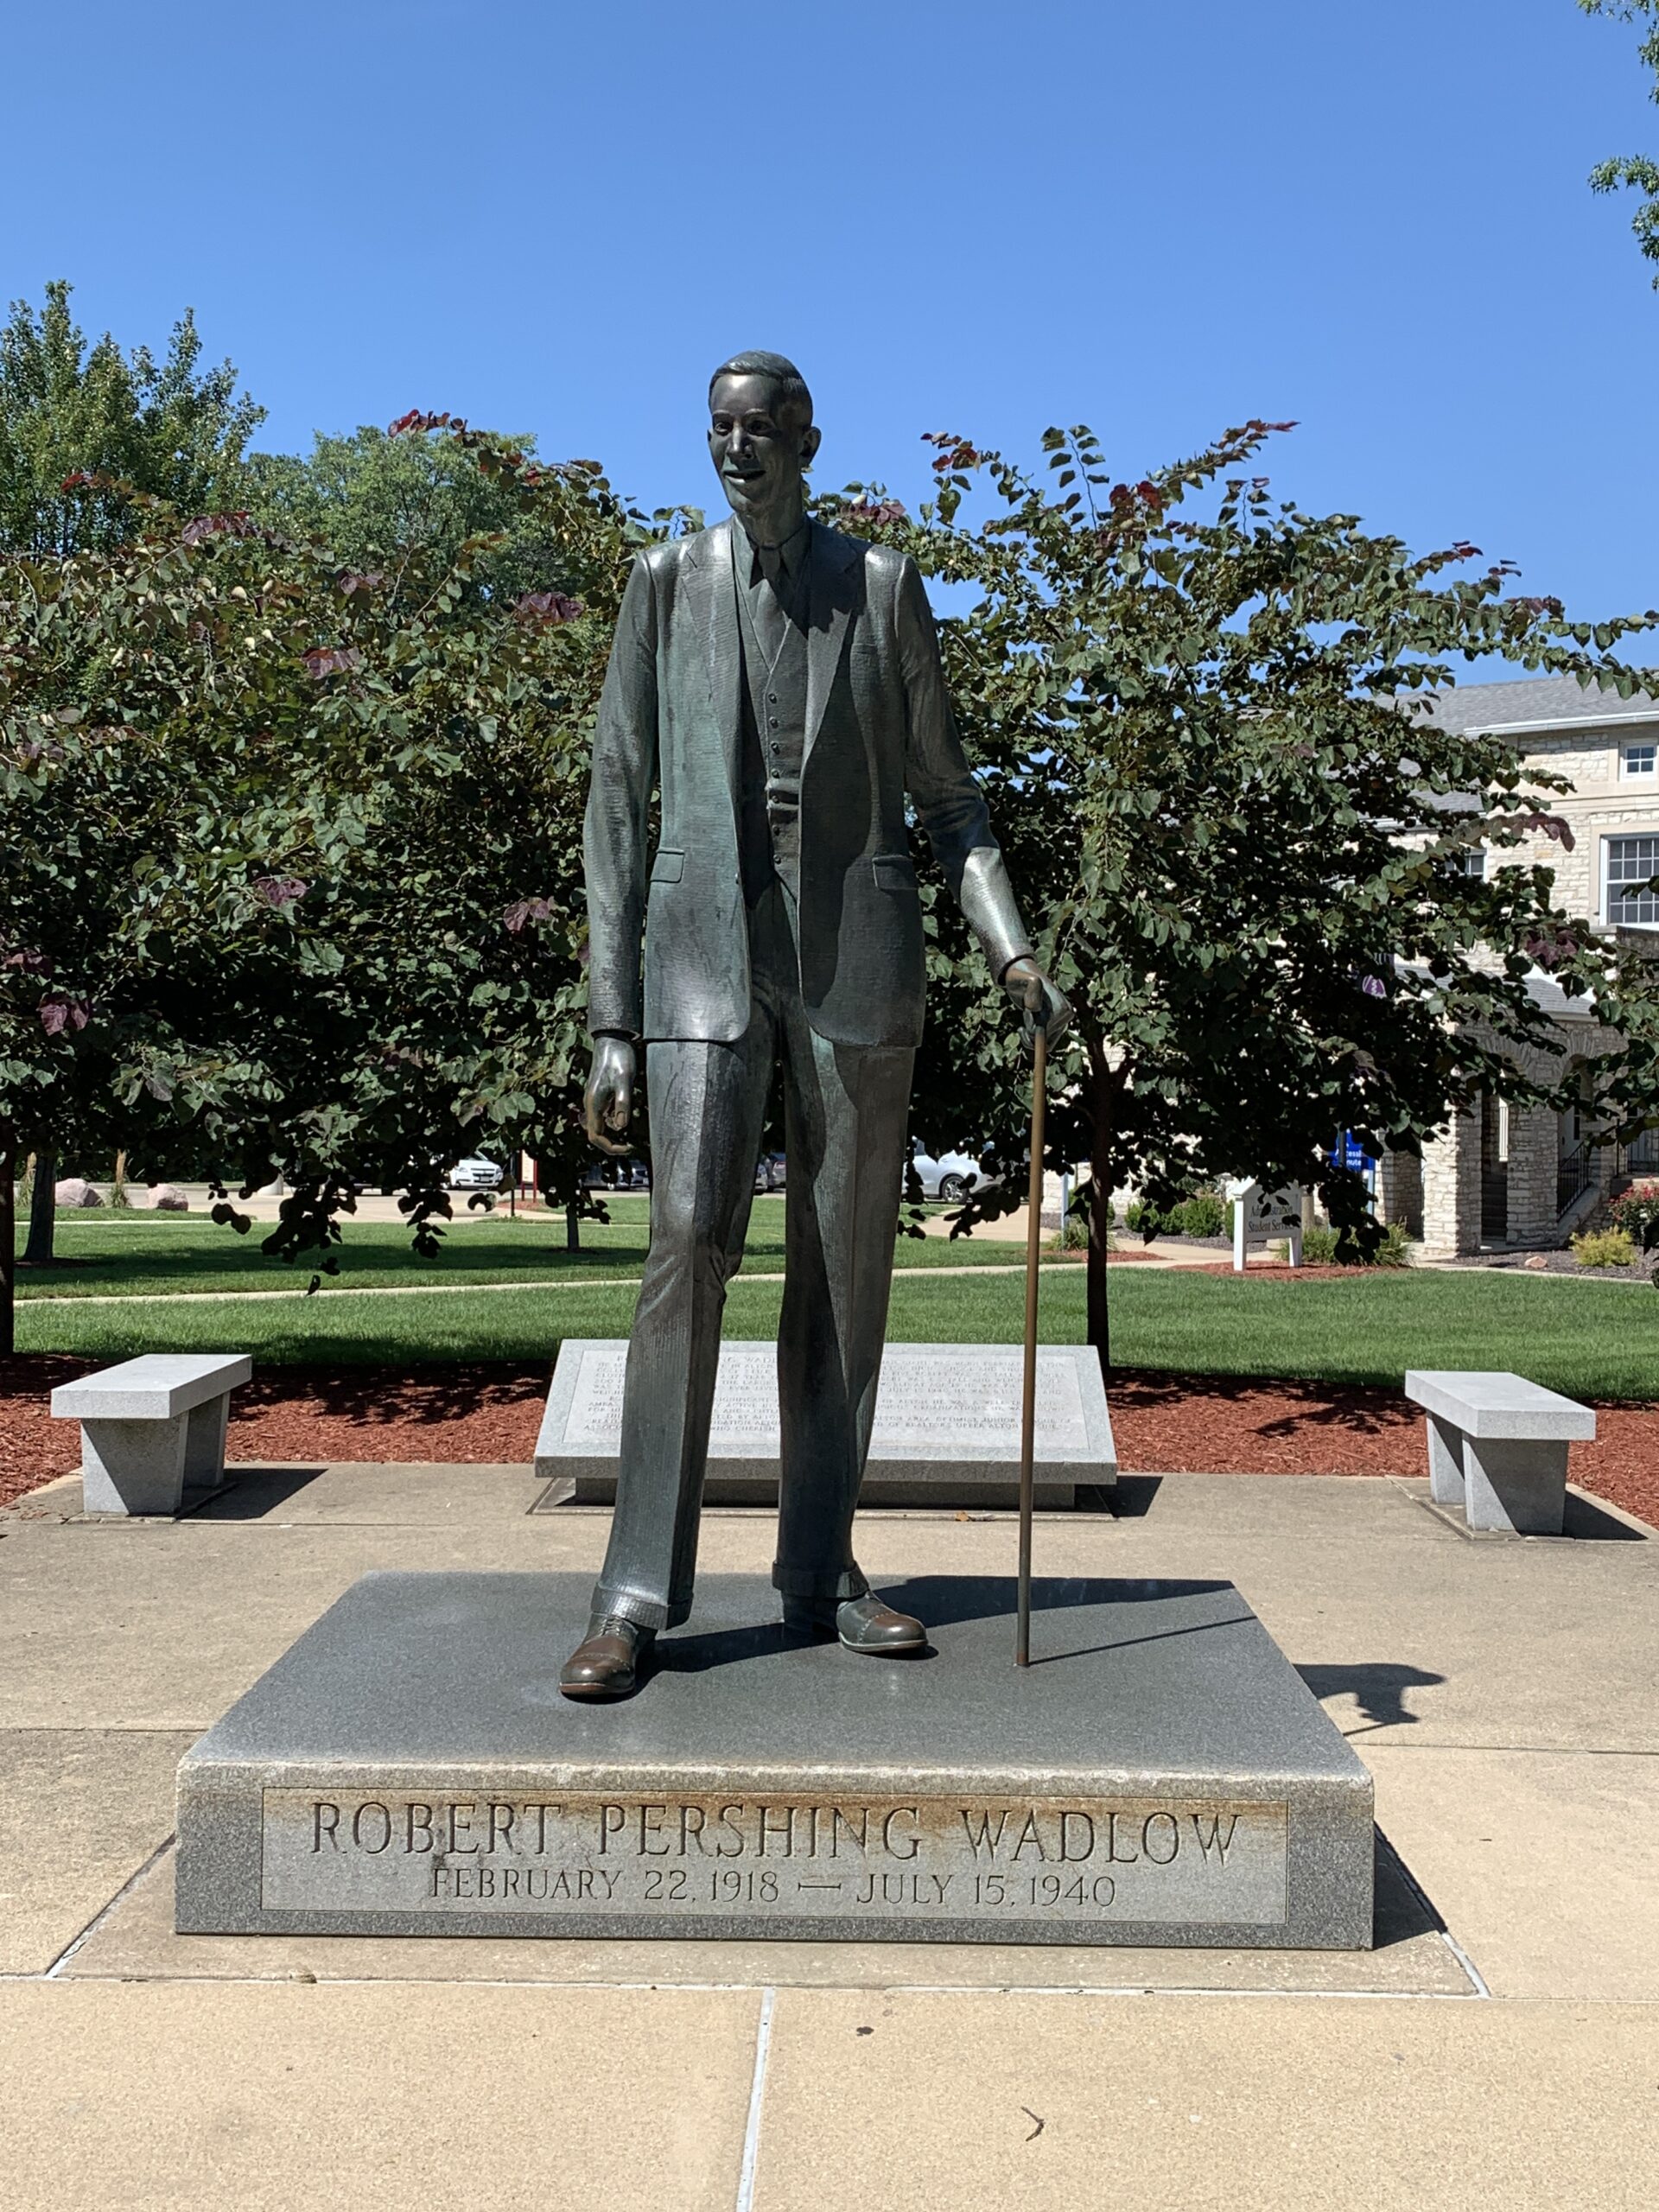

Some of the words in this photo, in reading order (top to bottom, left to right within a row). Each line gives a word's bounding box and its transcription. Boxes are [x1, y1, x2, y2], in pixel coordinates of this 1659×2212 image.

[1248, 1220, 1271, 1233] Student
[310, 1801, 562, 1857] ROBERT
[596, 1803, 923, 1860] PERSHING
[957, 1808, 1244, 1866] WADLOW
[431, 1868, 622, 1900] FEBRUARY
[856, 1873, 953, 1905] JULY
